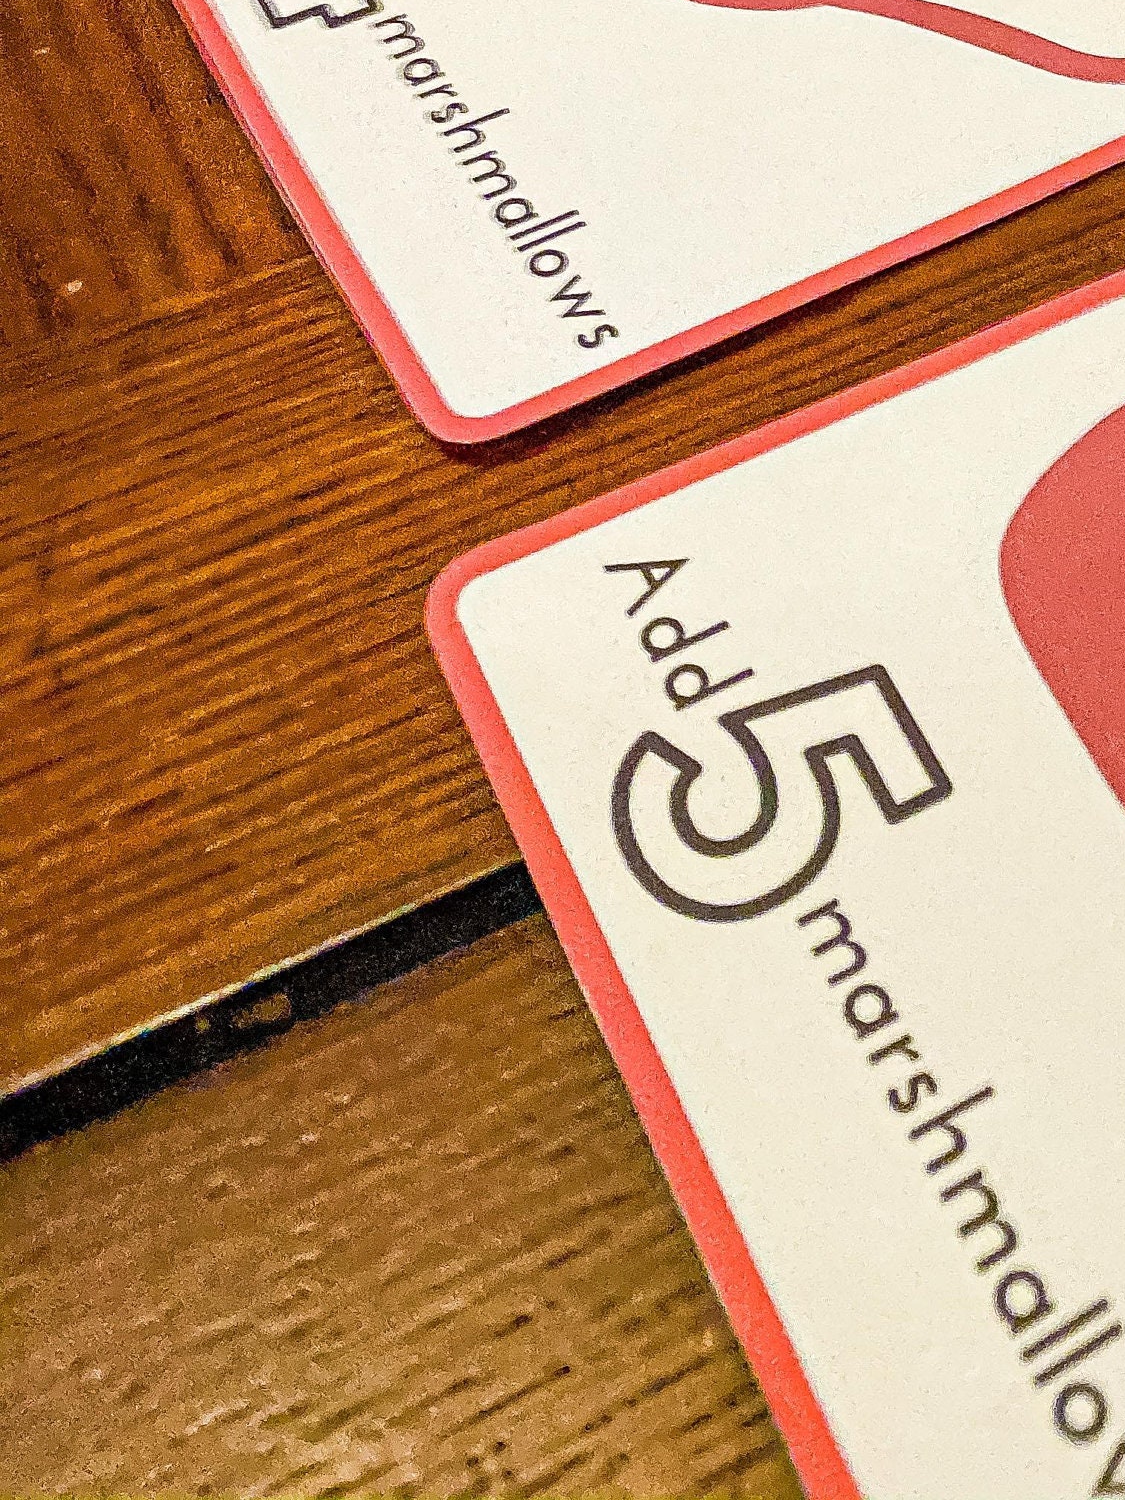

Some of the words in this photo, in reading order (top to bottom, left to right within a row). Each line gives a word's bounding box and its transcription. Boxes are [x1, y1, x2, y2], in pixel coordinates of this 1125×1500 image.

[373, 13, 620, 350] marshmallows
[603, 558, 755, 712] Add
[610, 663, 954, 924] 5
